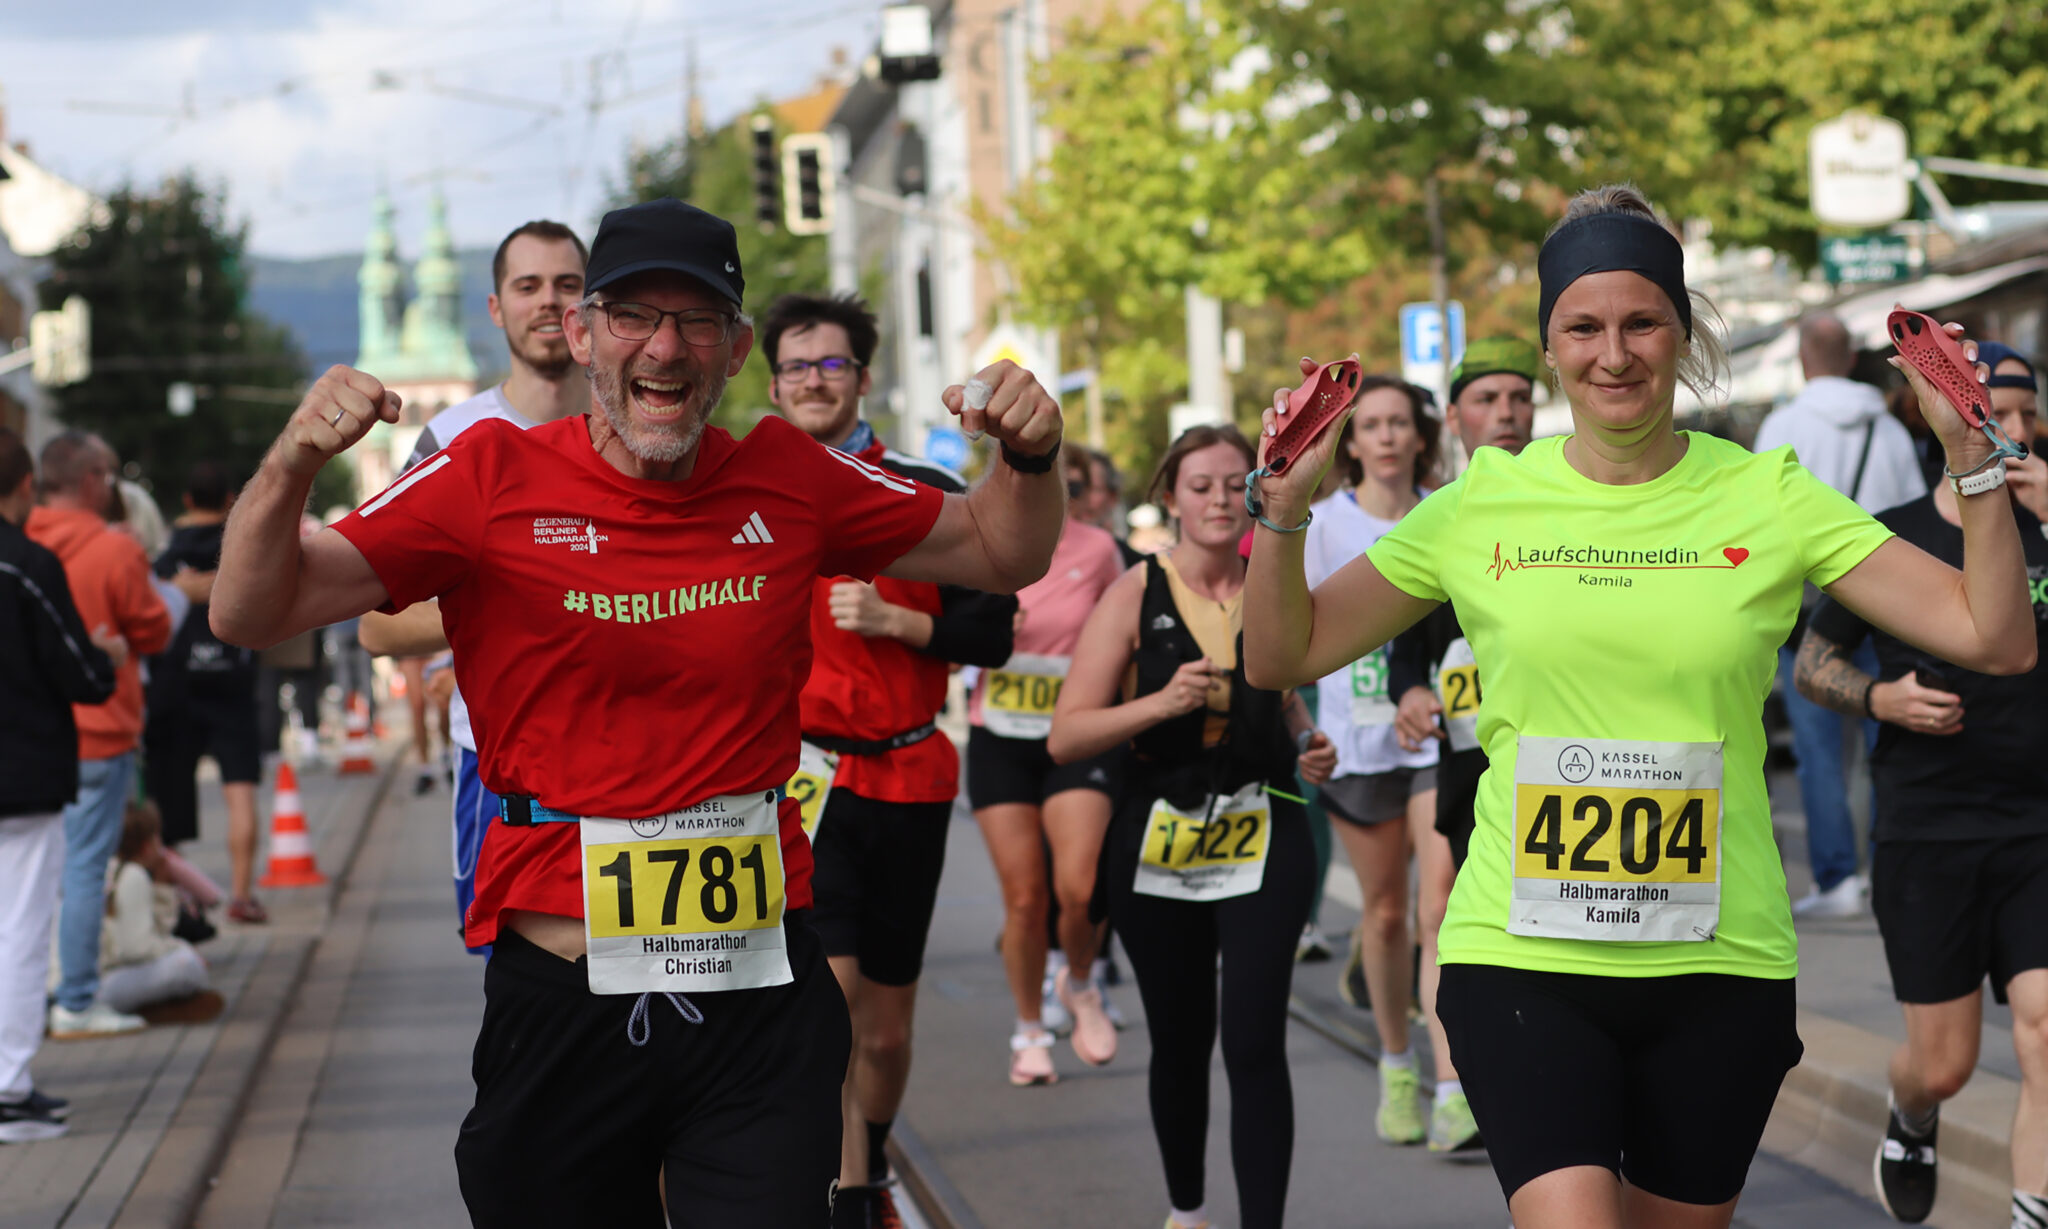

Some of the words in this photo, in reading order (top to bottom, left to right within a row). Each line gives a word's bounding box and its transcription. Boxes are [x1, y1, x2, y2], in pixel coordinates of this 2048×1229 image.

[545, 517, 586, 526] GENERALI
[533, 527, 578, 536] BERLINER
[570, 543, 589, 552] 2024
[1517, 545, 1699, 564] Laufschunneldin
[1578, 573, 1633, 588] Kamila
[563, 575, 767, 624] #BERLINHALF
[1601, 751, 1659, 765] KASSEL
[1600, 767, 1683, 781] MARATHON
[675, 817, 745, 830] MARATHON
[1158, 815, 1260, 864] 1722
[1524, 794, 1708, 875] 4204
[599, 843, 768, 928] 1781
[1559, 882, 1669, 901] Halbmarathon
[1586, 905, 1641, 924] Kamila
[643, 933, 747, 954] Halbmarathon
[665, 957, 733, 975] Christian
